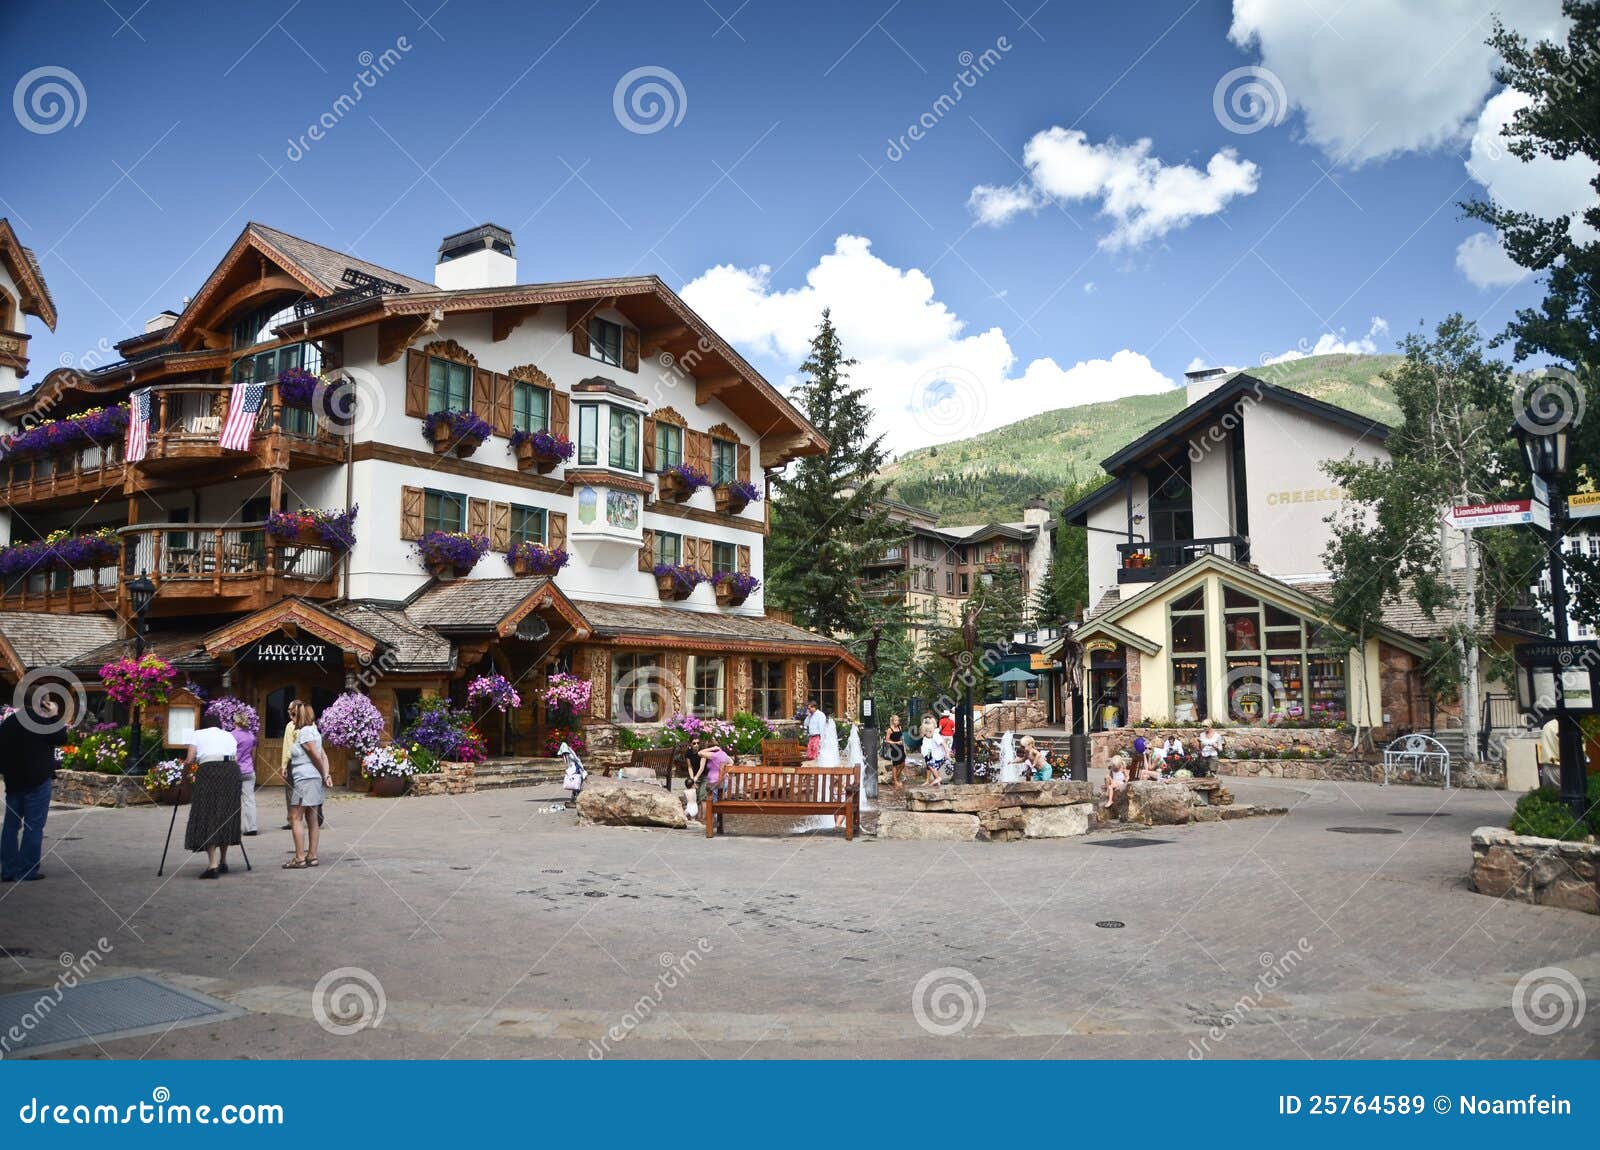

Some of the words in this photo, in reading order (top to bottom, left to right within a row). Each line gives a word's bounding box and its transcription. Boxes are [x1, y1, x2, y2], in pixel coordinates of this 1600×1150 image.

[1266, 487, 1347, 506] CREEKS
[1455, 505, 1493, 516] LionsHead
[1493, 503, 1520, 513] Village
